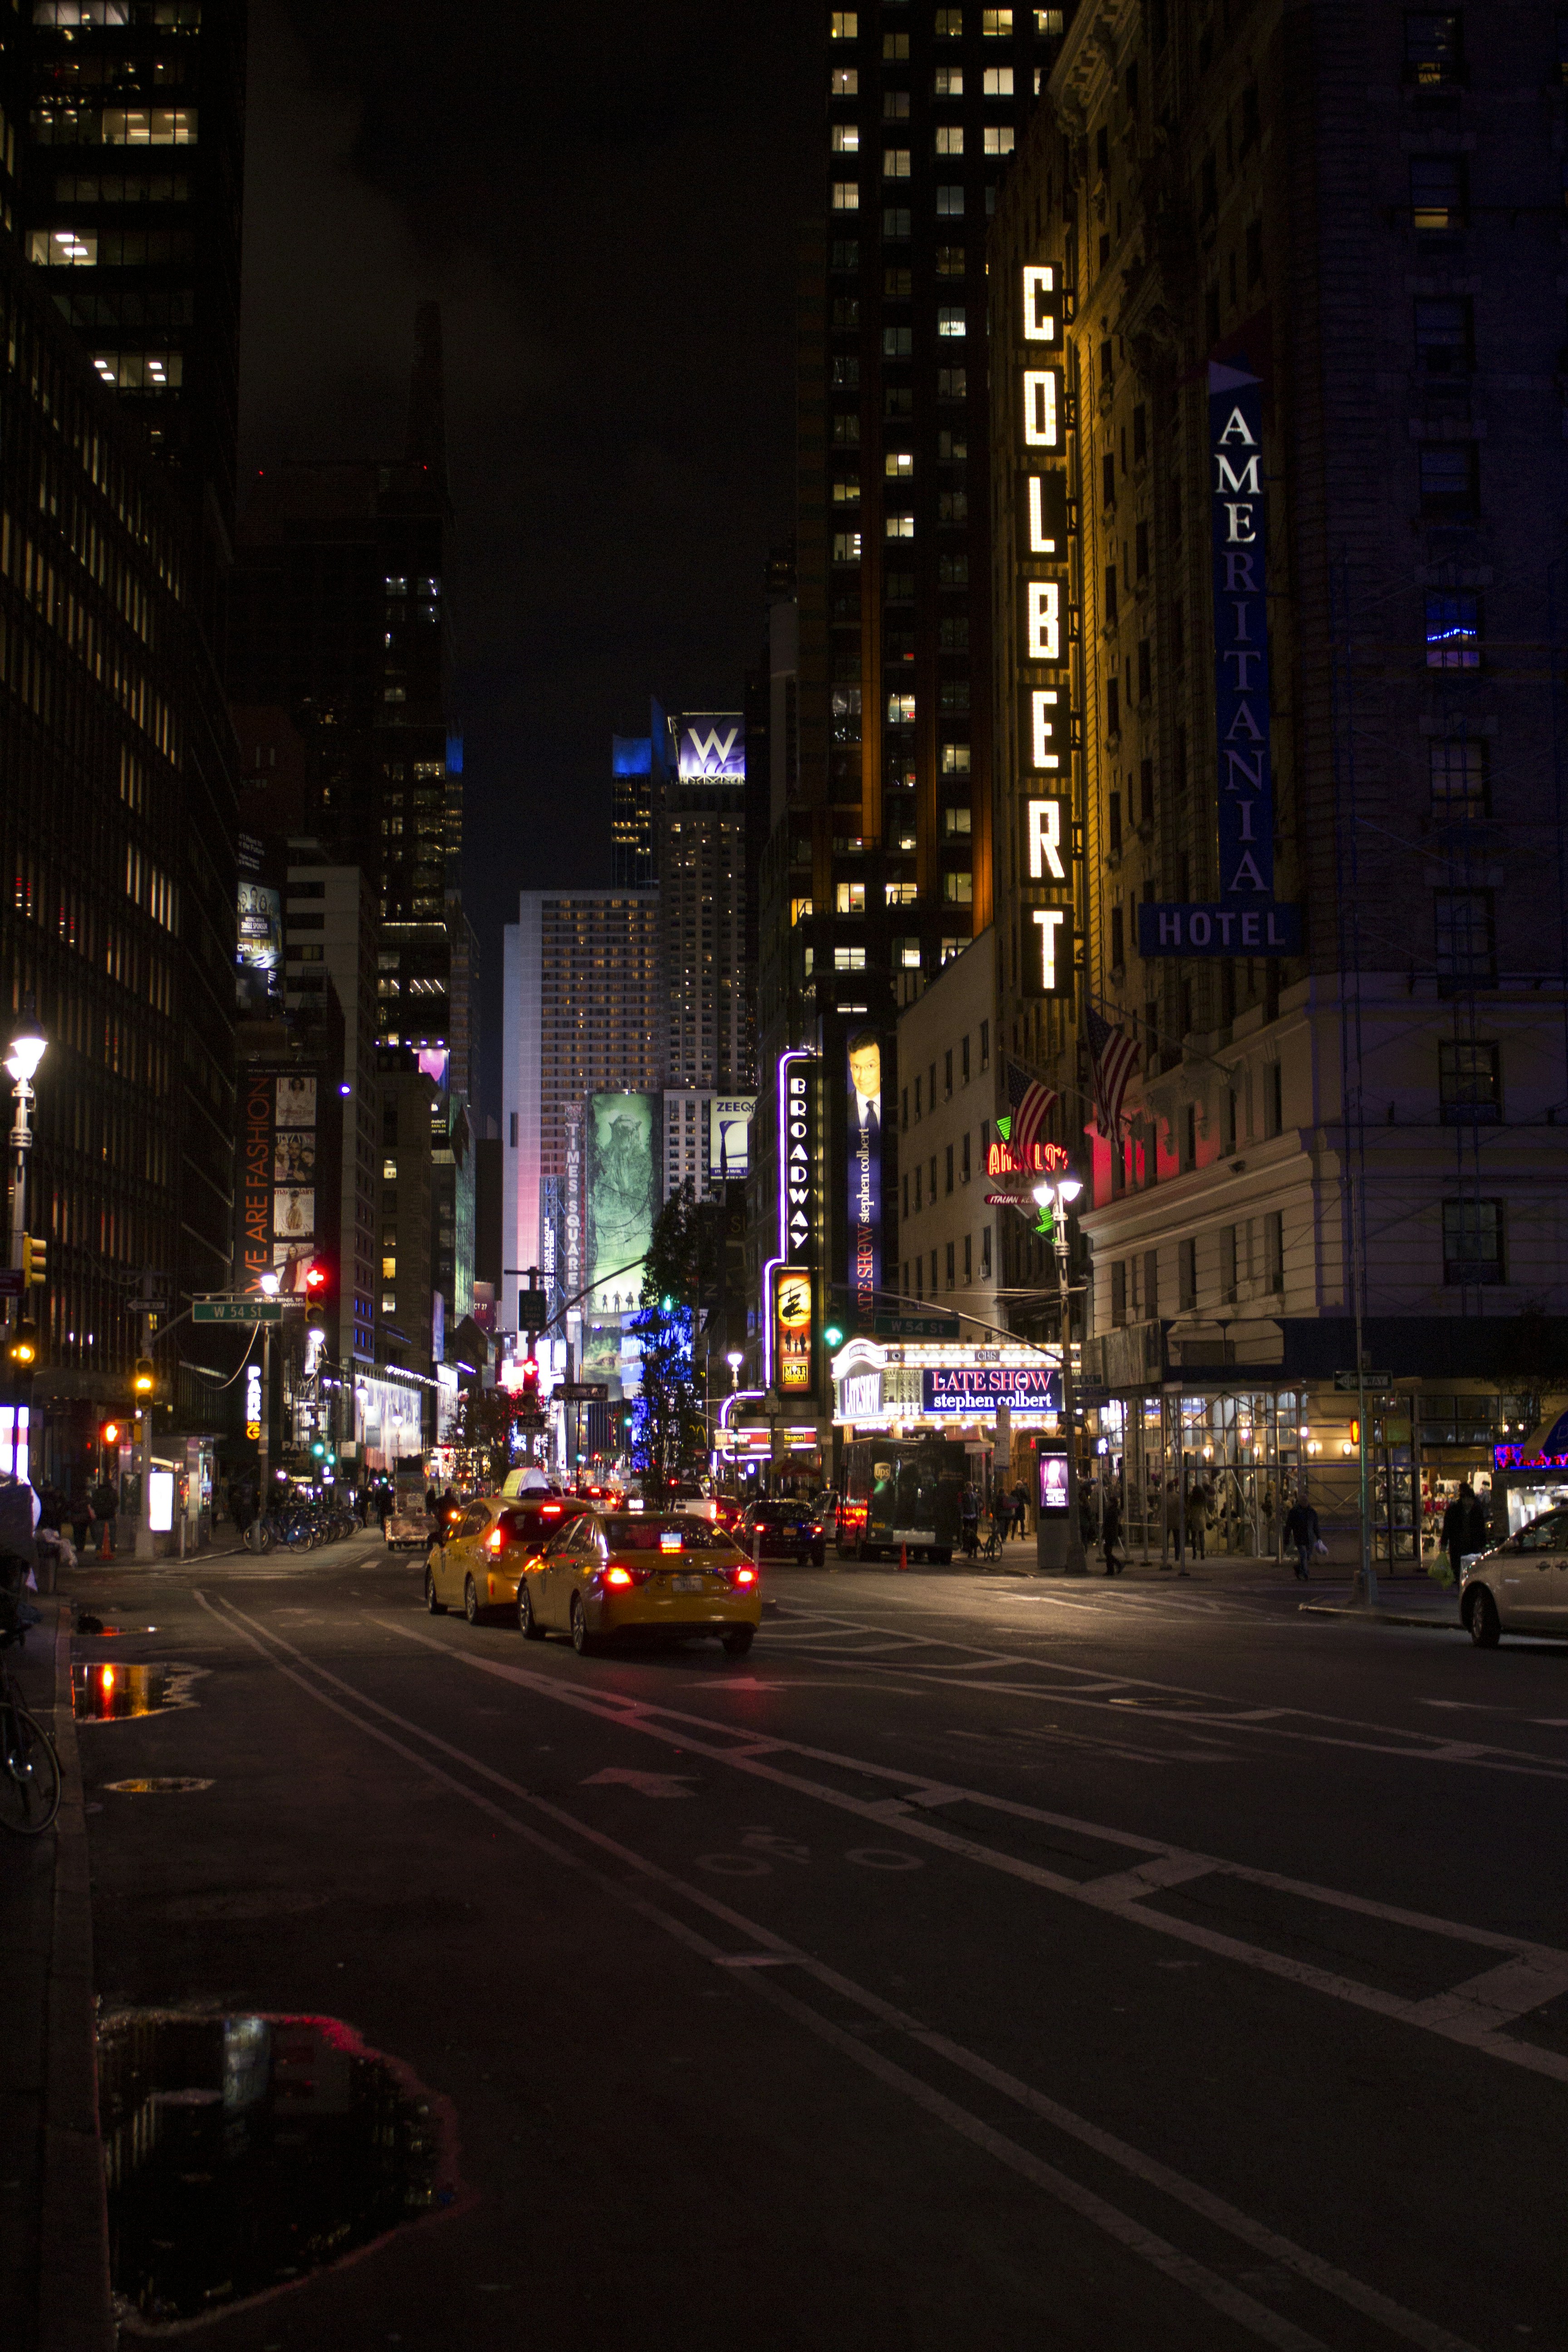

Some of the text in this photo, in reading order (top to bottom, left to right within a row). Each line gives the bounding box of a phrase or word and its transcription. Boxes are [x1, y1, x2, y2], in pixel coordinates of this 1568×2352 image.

[1024, 266, 1065, 990] COLBERT
[1214, 405, 1269, 892] AMERITANIA
[688, 728, 738, 764] W
[1159, 911, 1286, 946] HOTEL
[237, 944, 275, 953] ORVILLE
[716, 1101, 752, 1112] ZEEQ
[246, 1077, 271, 1187] FASHION
[856, 1127, 869, 1172] colbert
[789, 1078, 809, 1249] BROADWAY
[567, 1123, 579, 1285] TIMES SQUARE
[856, 1173, 874, 1223] stephen
[990, 1195, 1019, 1205] ITALIAN
[245, 1196, 269, 1242] ARE
[857, 1223, 873, 1279] SHOW
[214, 1306, 262, 1318] W 54 St
[891, 1320, 944, 1334] W 54 St
[978, 1351, 997, 1361] CBS
[248, 1366, 261, 1421] PARK
[785, 1373, 806, 1382] Saigon
[932, 1371, 1053, 1391] LATE SHOW
[1367, 1376, 1383, 1386] WAY
[934, 1391, 1051, 1412] stephen colbert
[875, 1469, 890, 1480] ups
